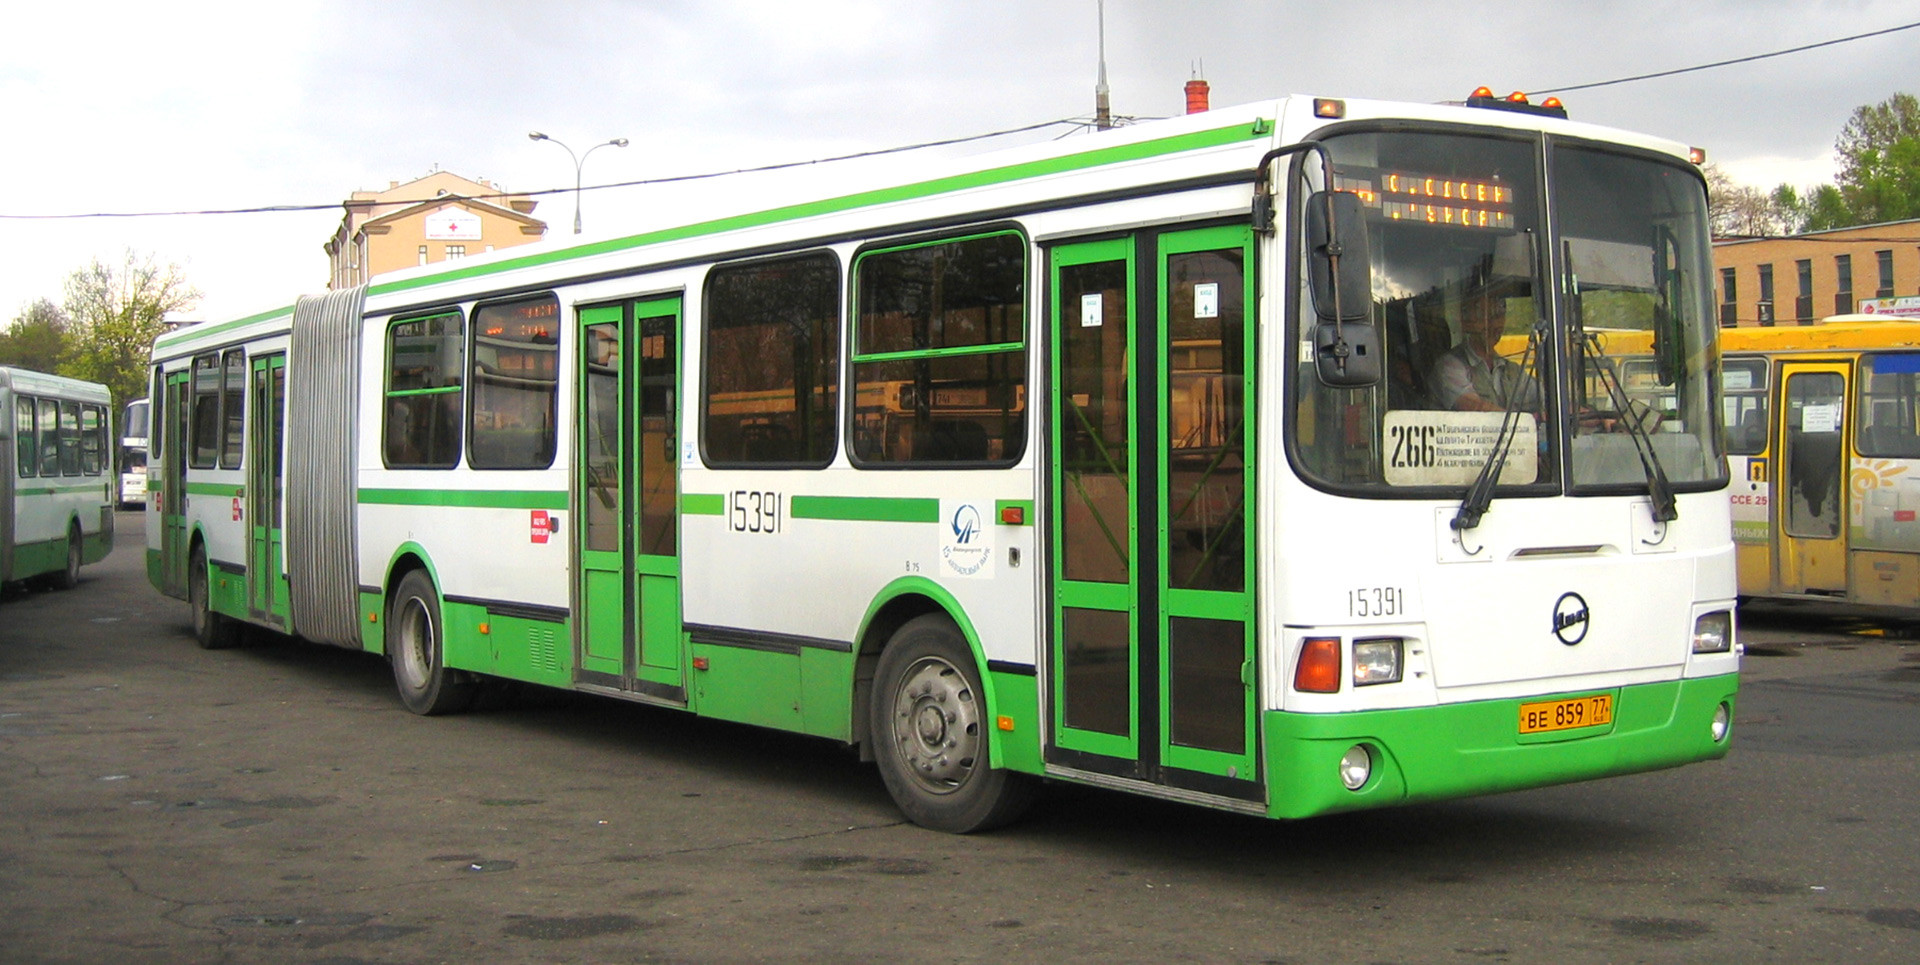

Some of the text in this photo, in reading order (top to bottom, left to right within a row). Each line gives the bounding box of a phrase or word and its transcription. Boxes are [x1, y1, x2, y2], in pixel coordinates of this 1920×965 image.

[1391, 425, 1435, 468] 266
[729, 490, 782, 533] 15391
[1349, 587, 1404, 617] 15391
[1528, 703, 1584, 729] ВЕ 859
[1592, 698, 1606, 715] 77
